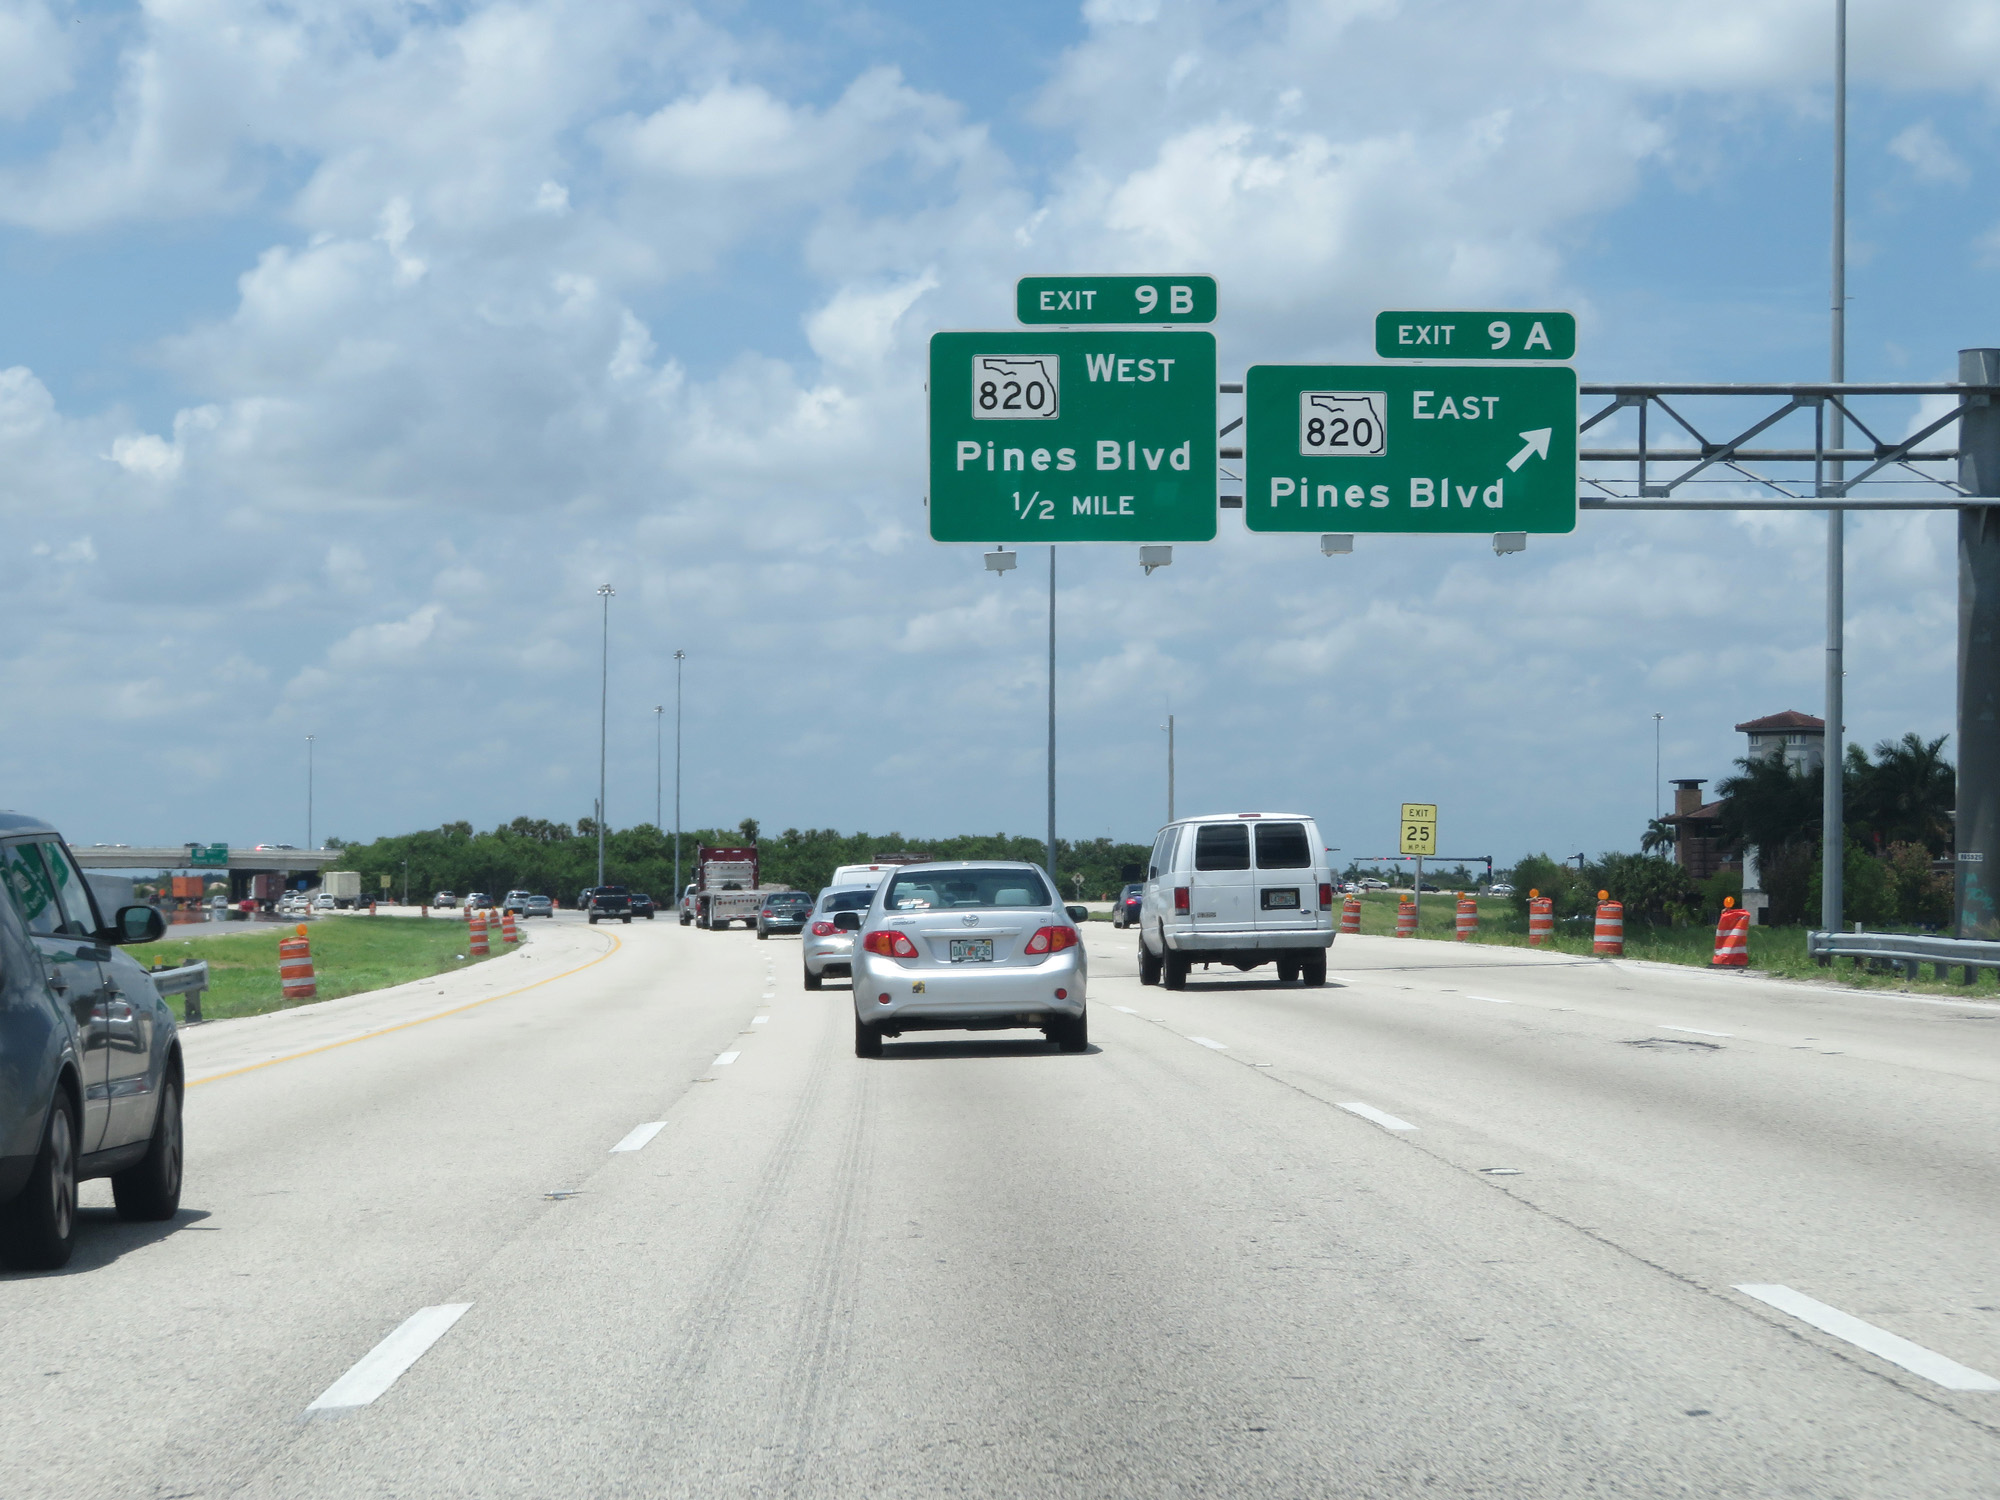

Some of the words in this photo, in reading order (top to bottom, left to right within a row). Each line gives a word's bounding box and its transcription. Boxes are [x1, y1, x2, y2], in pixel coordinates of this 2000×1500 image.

[1039, 291, 1097, 311] EXIT
[1398, 325, 1456, 345] EXIT
[1085, 353, 1176, 382] WEST
[979, 381, 1045, 410] 820
[1413, 390, 1500, 420] EAST
[1306, 417, 1373, 447] 820
[956, 440, 1077, 471] Pines
[1096, 440, 1190, 471] Blvd
[1012, 491, 1055, 520] 1/2
[1072, 495, 1135, 515] MILE
[1270, 476, 1390, 508] Pines
[1410, 477, 1504, 508] Blvd
[1409, 808, 1428, 817] EXIT
[1406, 825, 1429, 841] 25
